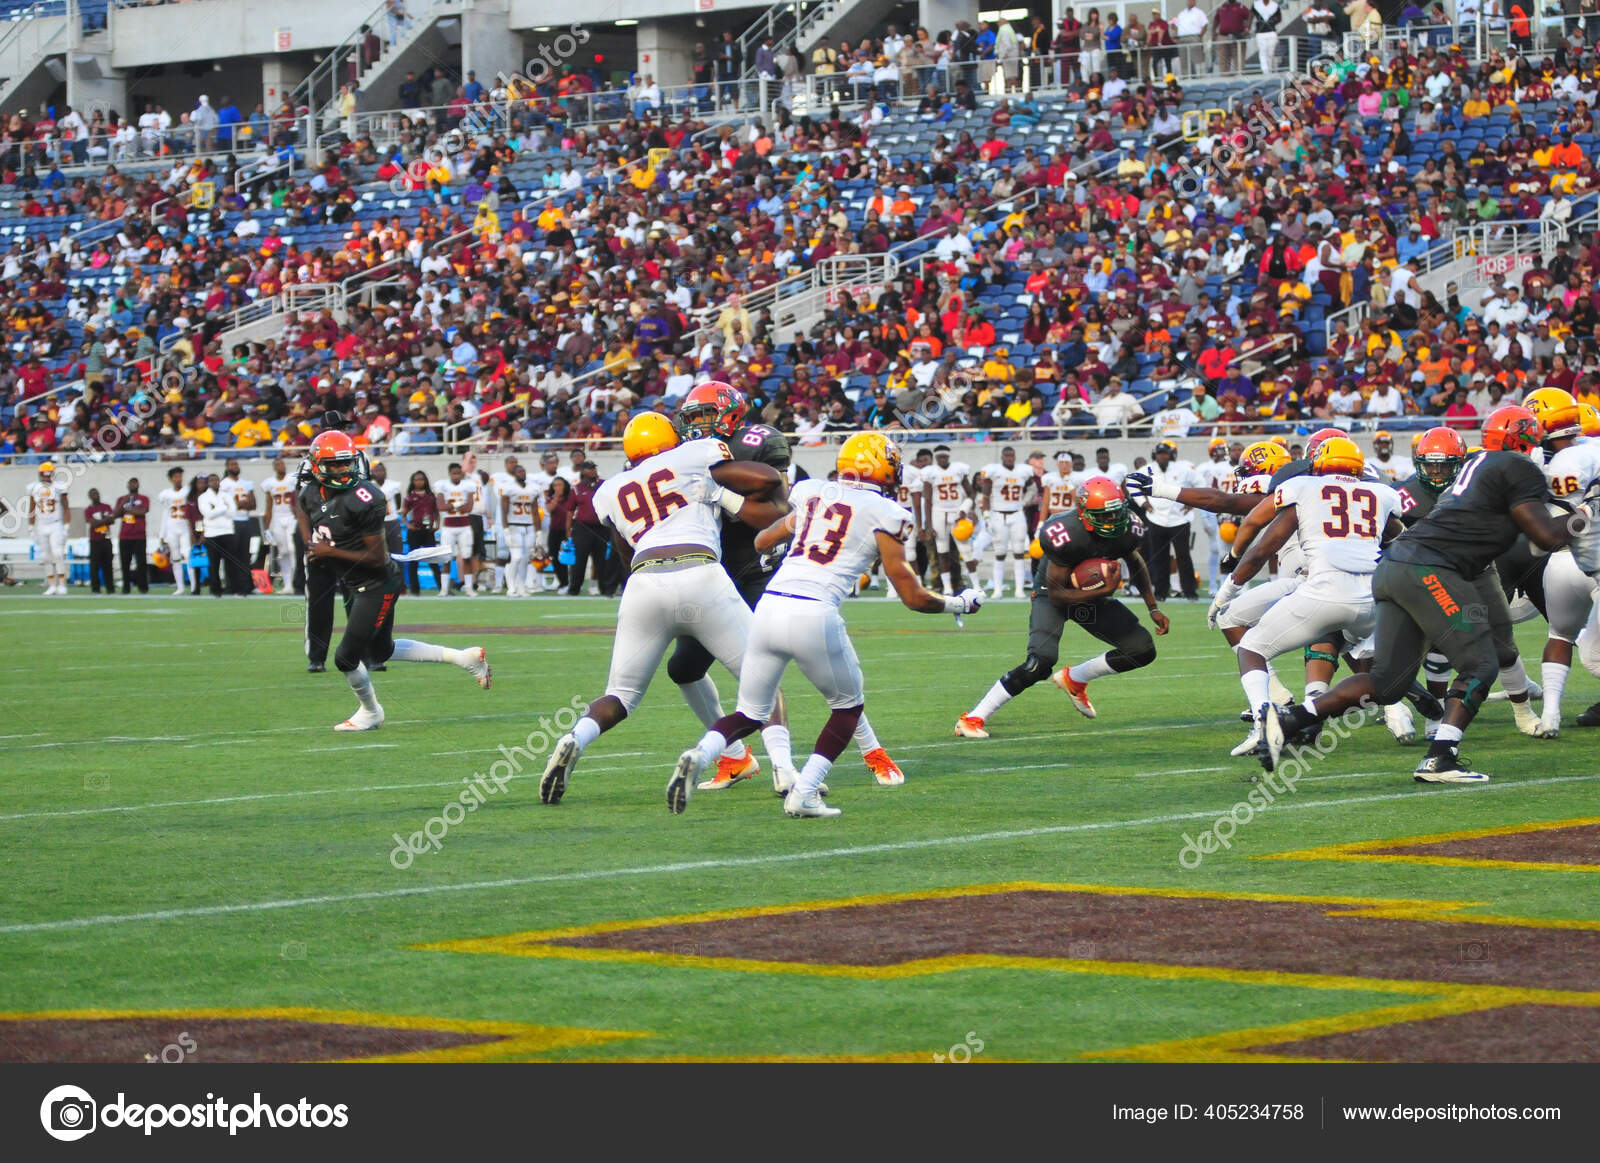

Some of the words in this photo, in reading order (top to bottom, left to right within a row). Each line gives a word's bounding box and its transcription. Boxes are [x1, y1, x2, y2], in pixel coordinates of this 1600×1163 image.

[742, 424, 771, 447] 85
[355, 487, 374, 503] 8
[937, 483, 959, 501] 55
[1000, 484, 1021, 501] 42
[1551, 475, 1579, 496] 46
[617, 467, 690, 544] 96
[1321, 484, 1378, 539] 33
[788, 496, 854, 567] 13
[1046, 520, 1072, 549] 25
[1422, 573, 1460, 617] STRIKE
